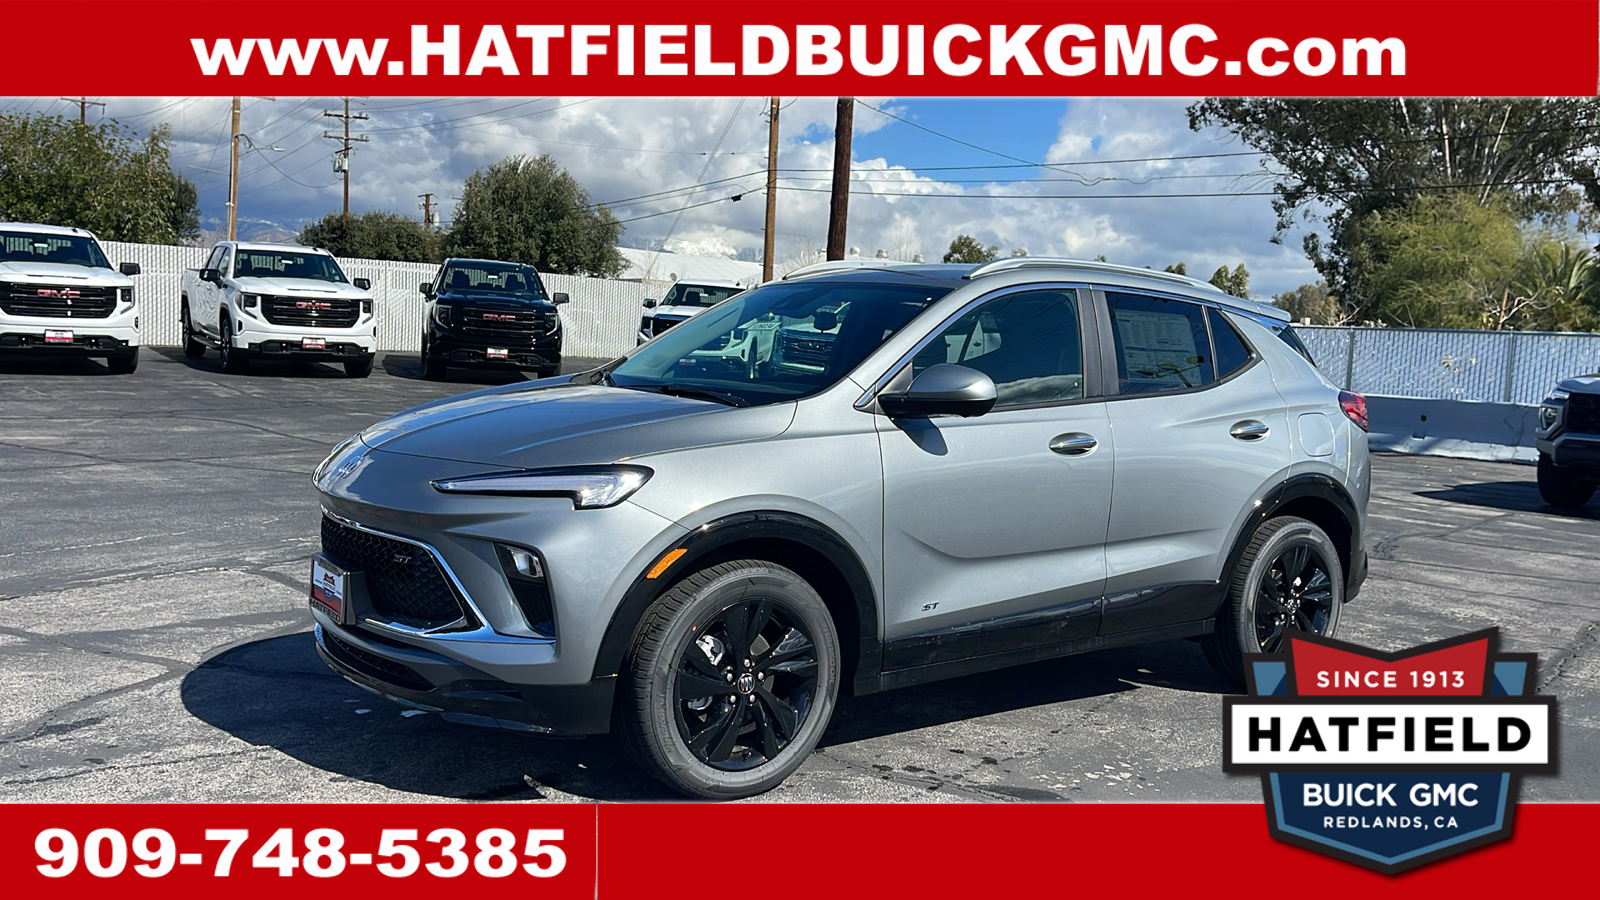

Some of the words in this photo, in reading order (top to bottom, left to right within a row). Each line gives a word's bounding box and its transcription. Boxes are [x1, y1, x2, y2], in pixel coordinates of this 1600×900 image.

[37, 289, 80, 298] GMC
[295, 301, 331, 310] GMC
[483, 313, 516, 322] GMC
[393, 553, 411, 563] ST
[921, 601, 940, 611] ST
